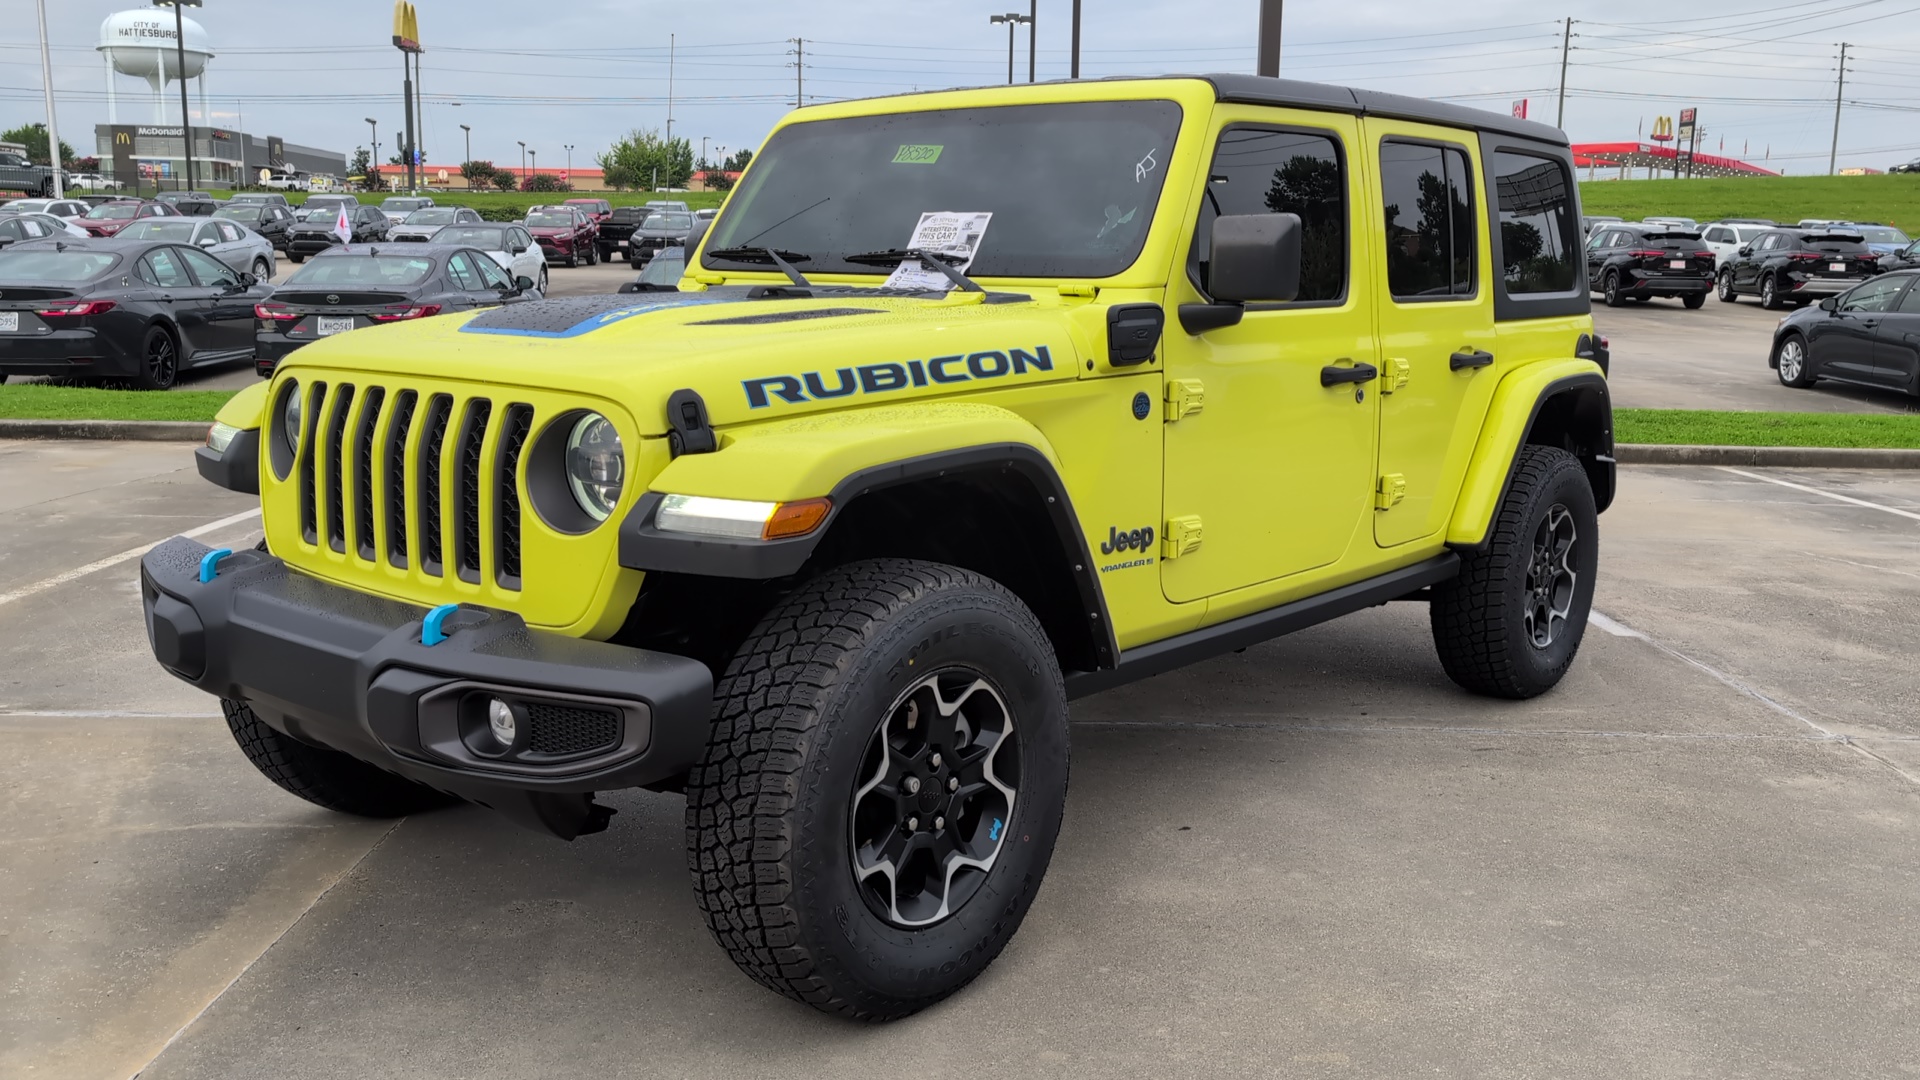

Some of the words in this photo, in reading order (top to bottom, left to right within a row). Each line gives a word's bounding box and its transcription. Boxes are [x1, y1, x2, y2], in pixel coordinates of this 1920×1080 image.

[118, 28, 178, 39] HATTIESBURG
[918, 232, 936, 240] THIS
[936, 232, 958, 240] CAR?
[740, 345, 1054, 410] RUBICON
[1100, 526, 1154, 555] Jeep
[1100, 559, 1145, 573] WRANGLER
[907, 622, 1042, 678] MILESTAR
